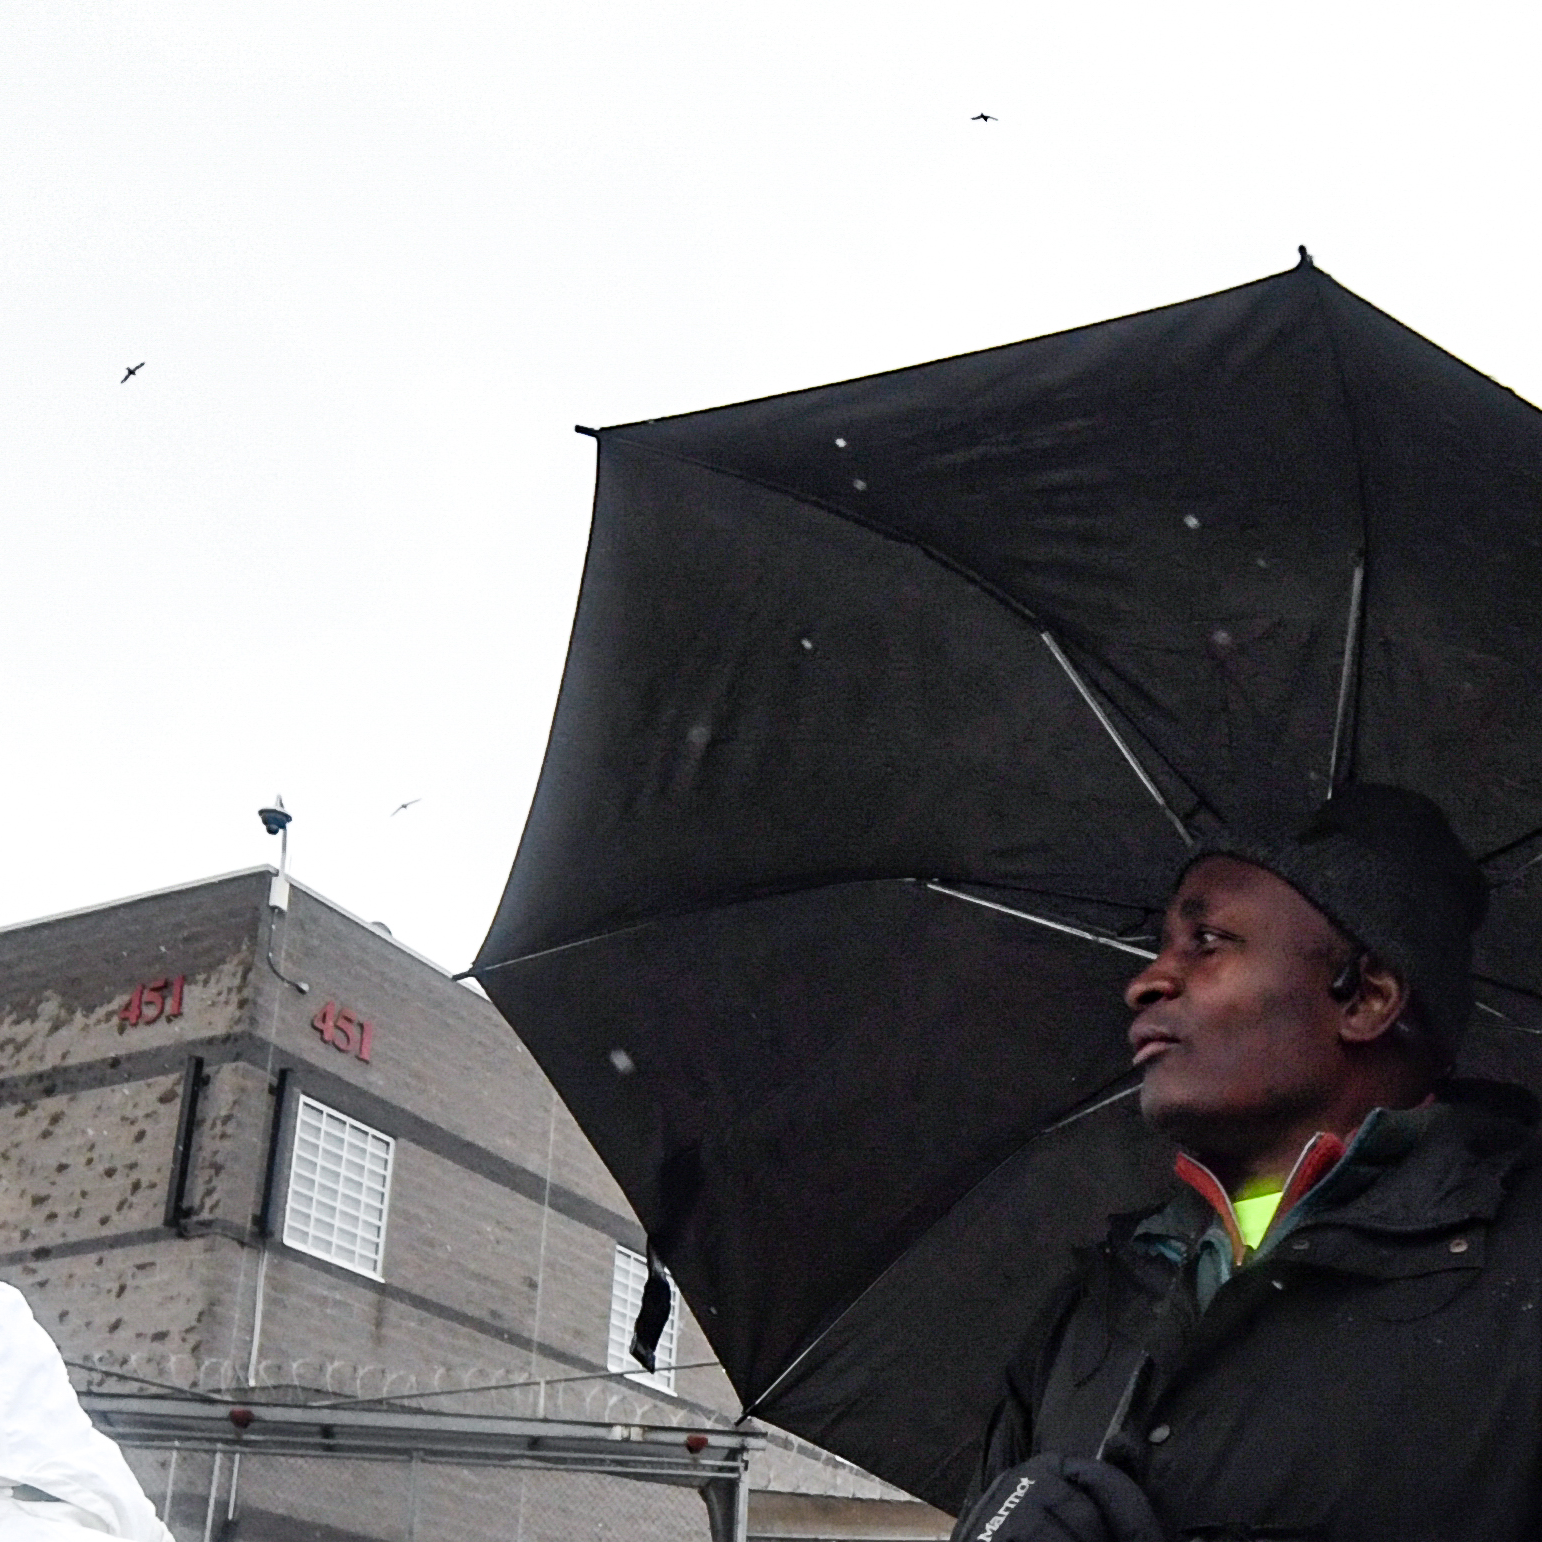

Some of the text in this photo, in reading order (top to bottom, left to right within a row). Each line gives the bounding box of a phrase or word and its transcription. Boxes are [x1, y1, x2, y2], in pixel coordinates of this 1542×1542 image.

[119, 974, 185, 1027] 451
[311, 1001, 373, 1064] 451
[977, 1477, 1035, 1542] Marmot
